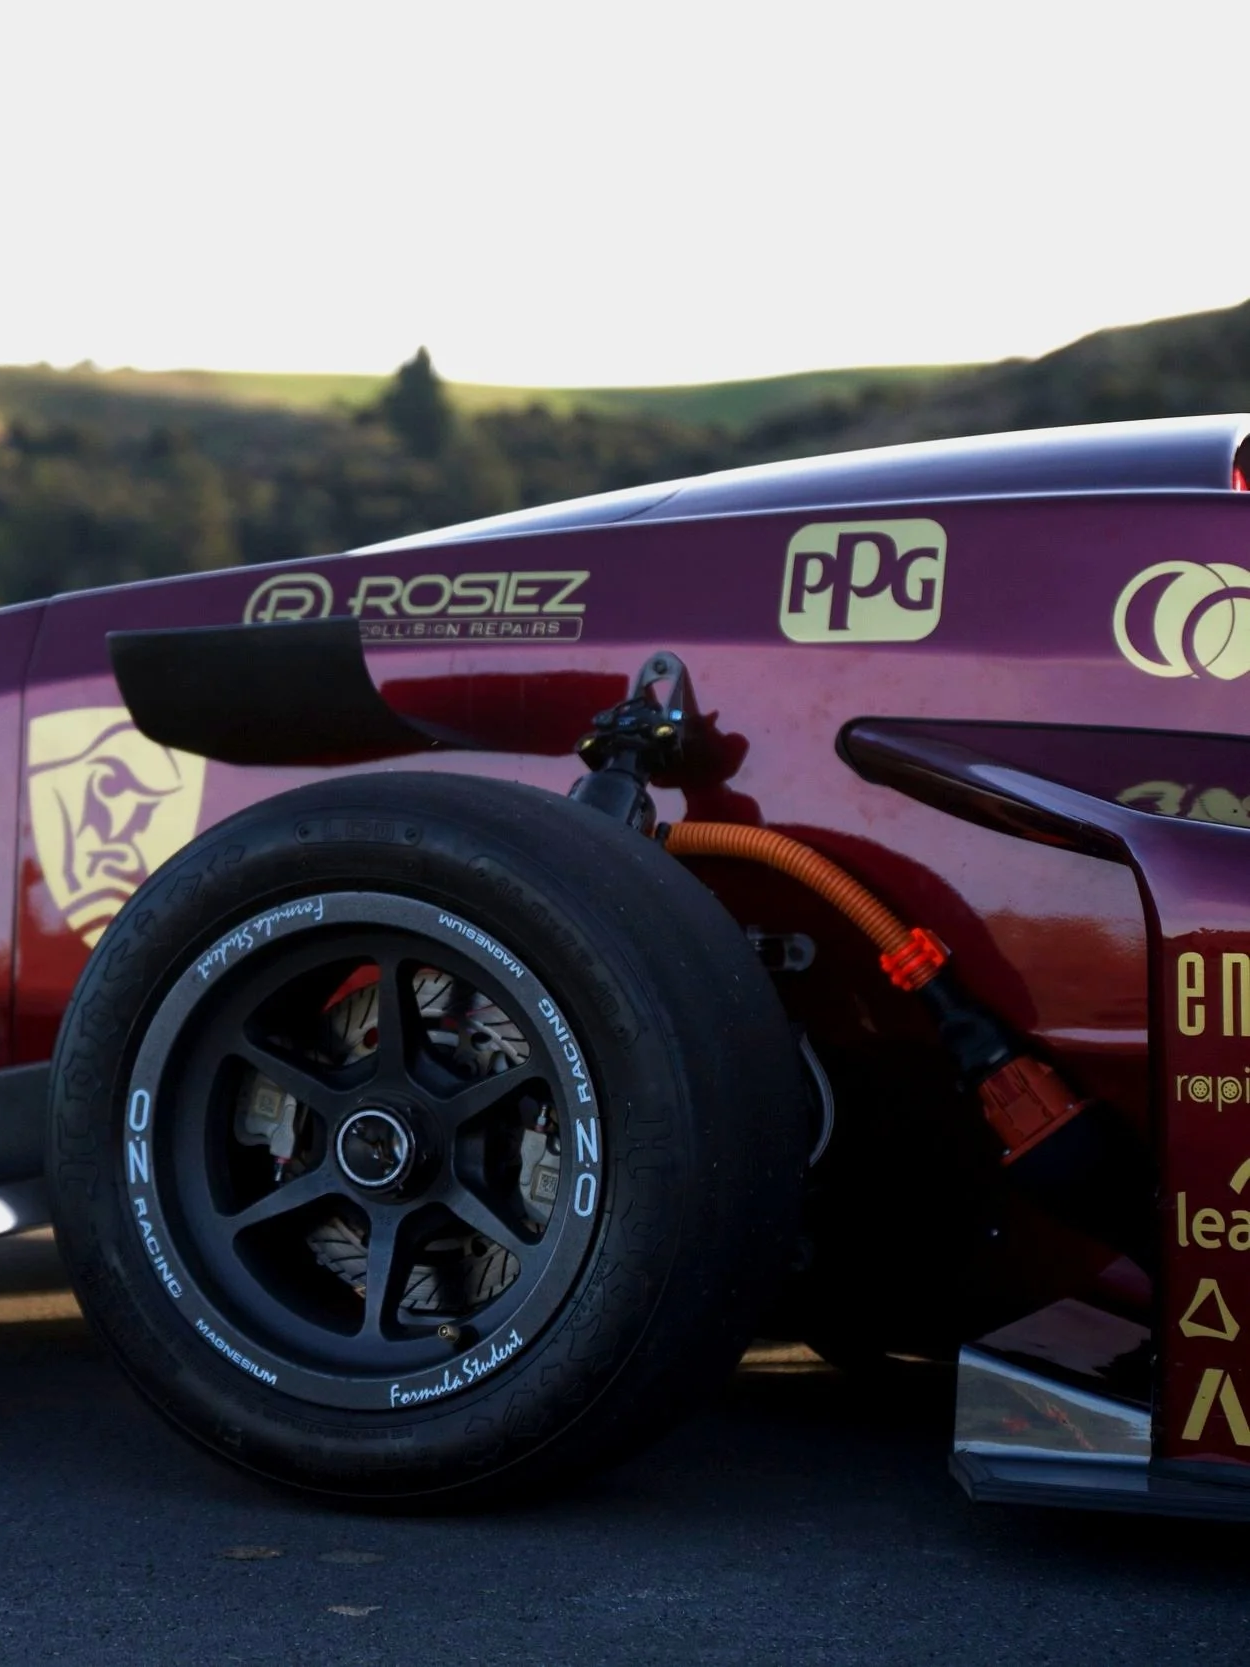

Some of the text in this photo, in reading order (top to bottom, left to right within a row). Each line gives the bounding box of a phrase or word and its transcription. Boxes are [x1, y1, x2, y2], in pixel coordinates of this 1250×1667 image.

[469, 621, 561, 637] REPAIRS
[438, 913, 524, 978] MAGNESIUM
[537, 997, 592, 1104] RACING
[134, 1197, 183, 1299] RACING
[195, 1318, 278, 1386] MAGNESIUM
[390, 1329, 523, 1408] Formula Student
